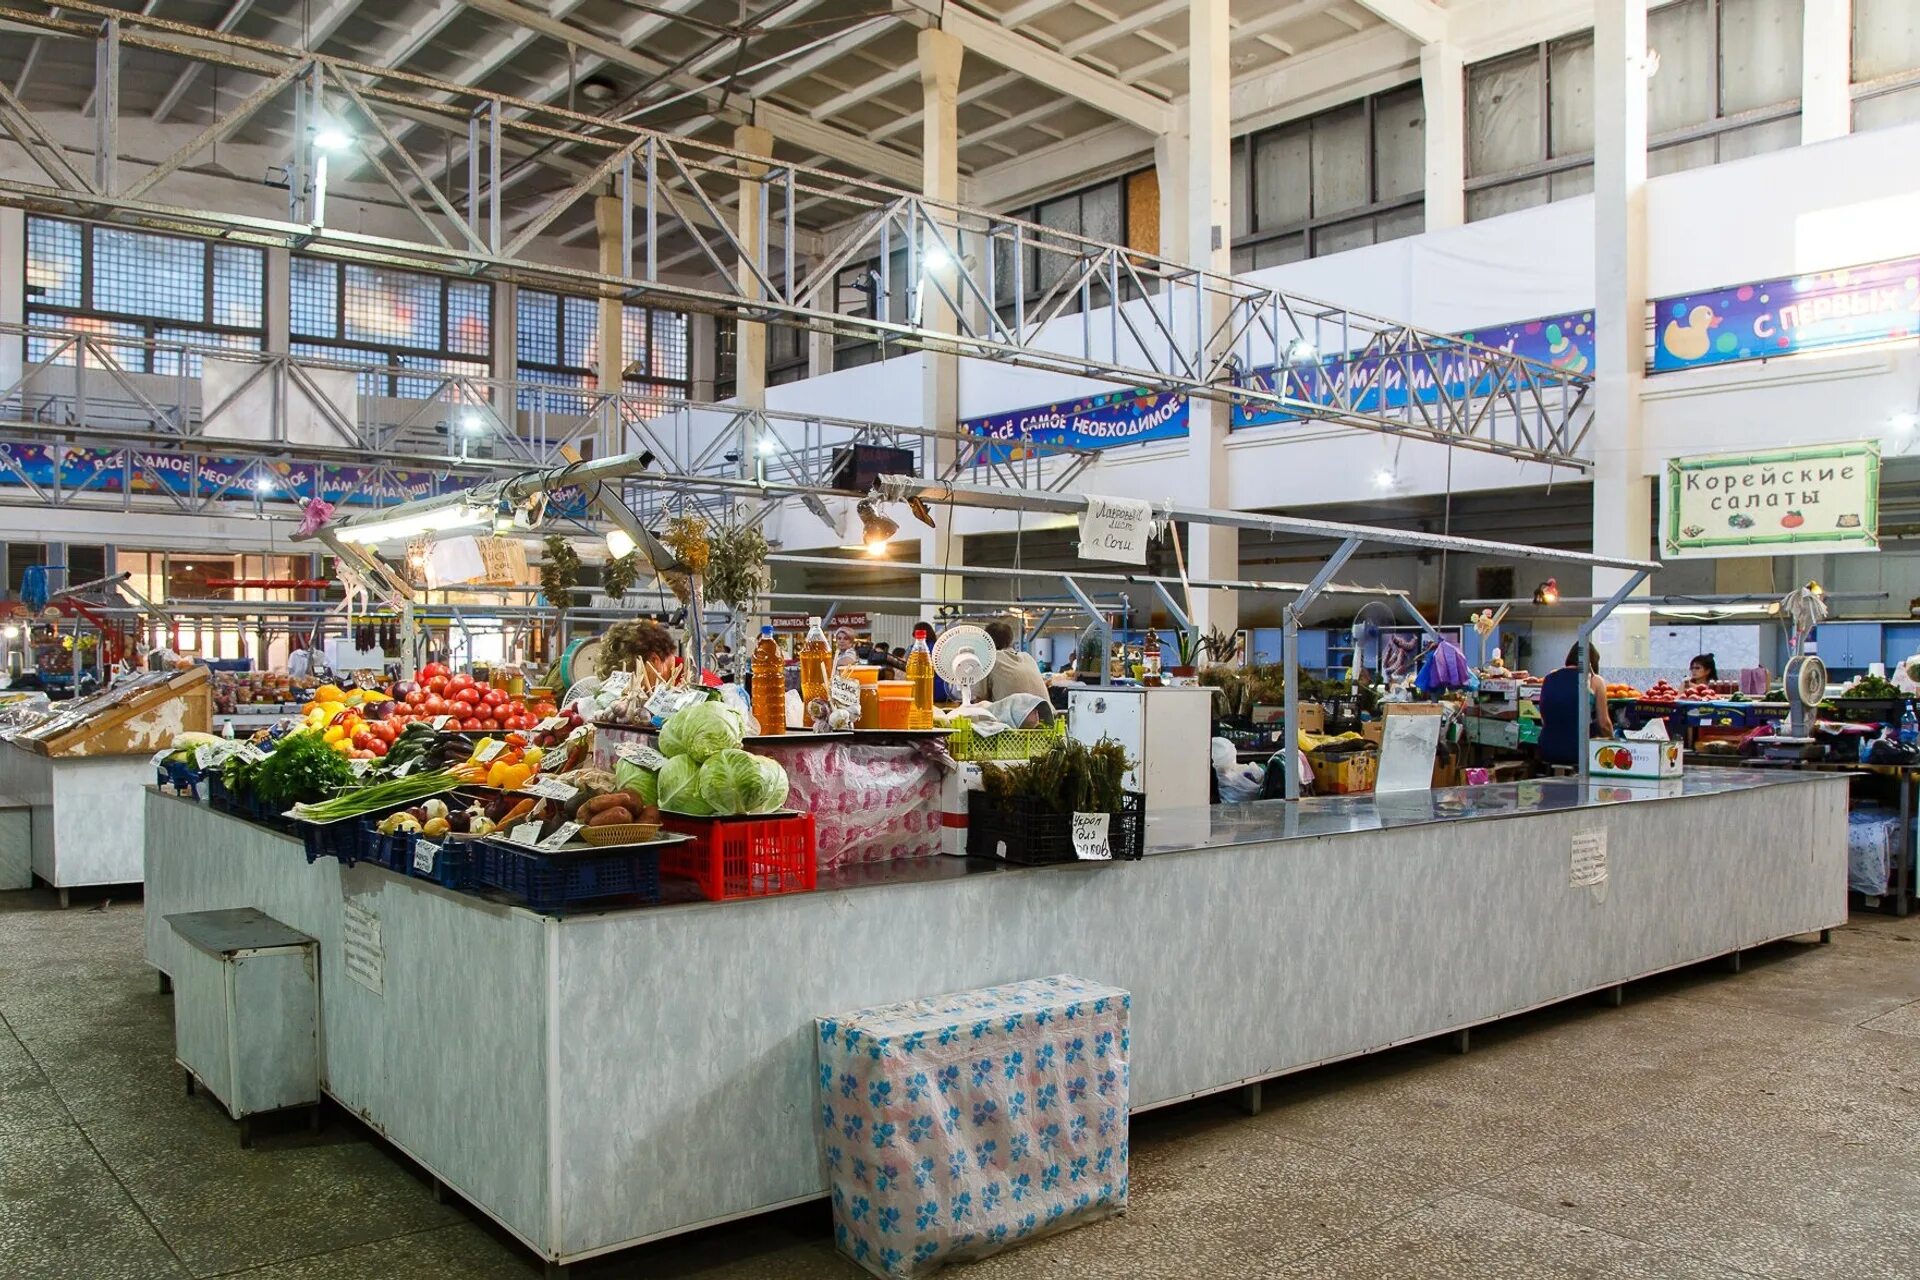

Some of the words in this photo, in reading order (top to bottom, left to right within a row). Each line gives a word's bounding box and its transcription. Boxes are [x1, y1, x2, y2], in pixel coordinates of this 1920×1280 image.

[1753, 313, 1776, 338] С
[1779, 286, 1899, 331] ПЕРВЫХ
[1020, 413, 1067, 432] САМОЕ
[1072, 393, 1181, 438] НЕОБХОДИМОЕ
[1687, 466, 1855, 494] Корейские
[1711, 490, 1820, 510] салаты
